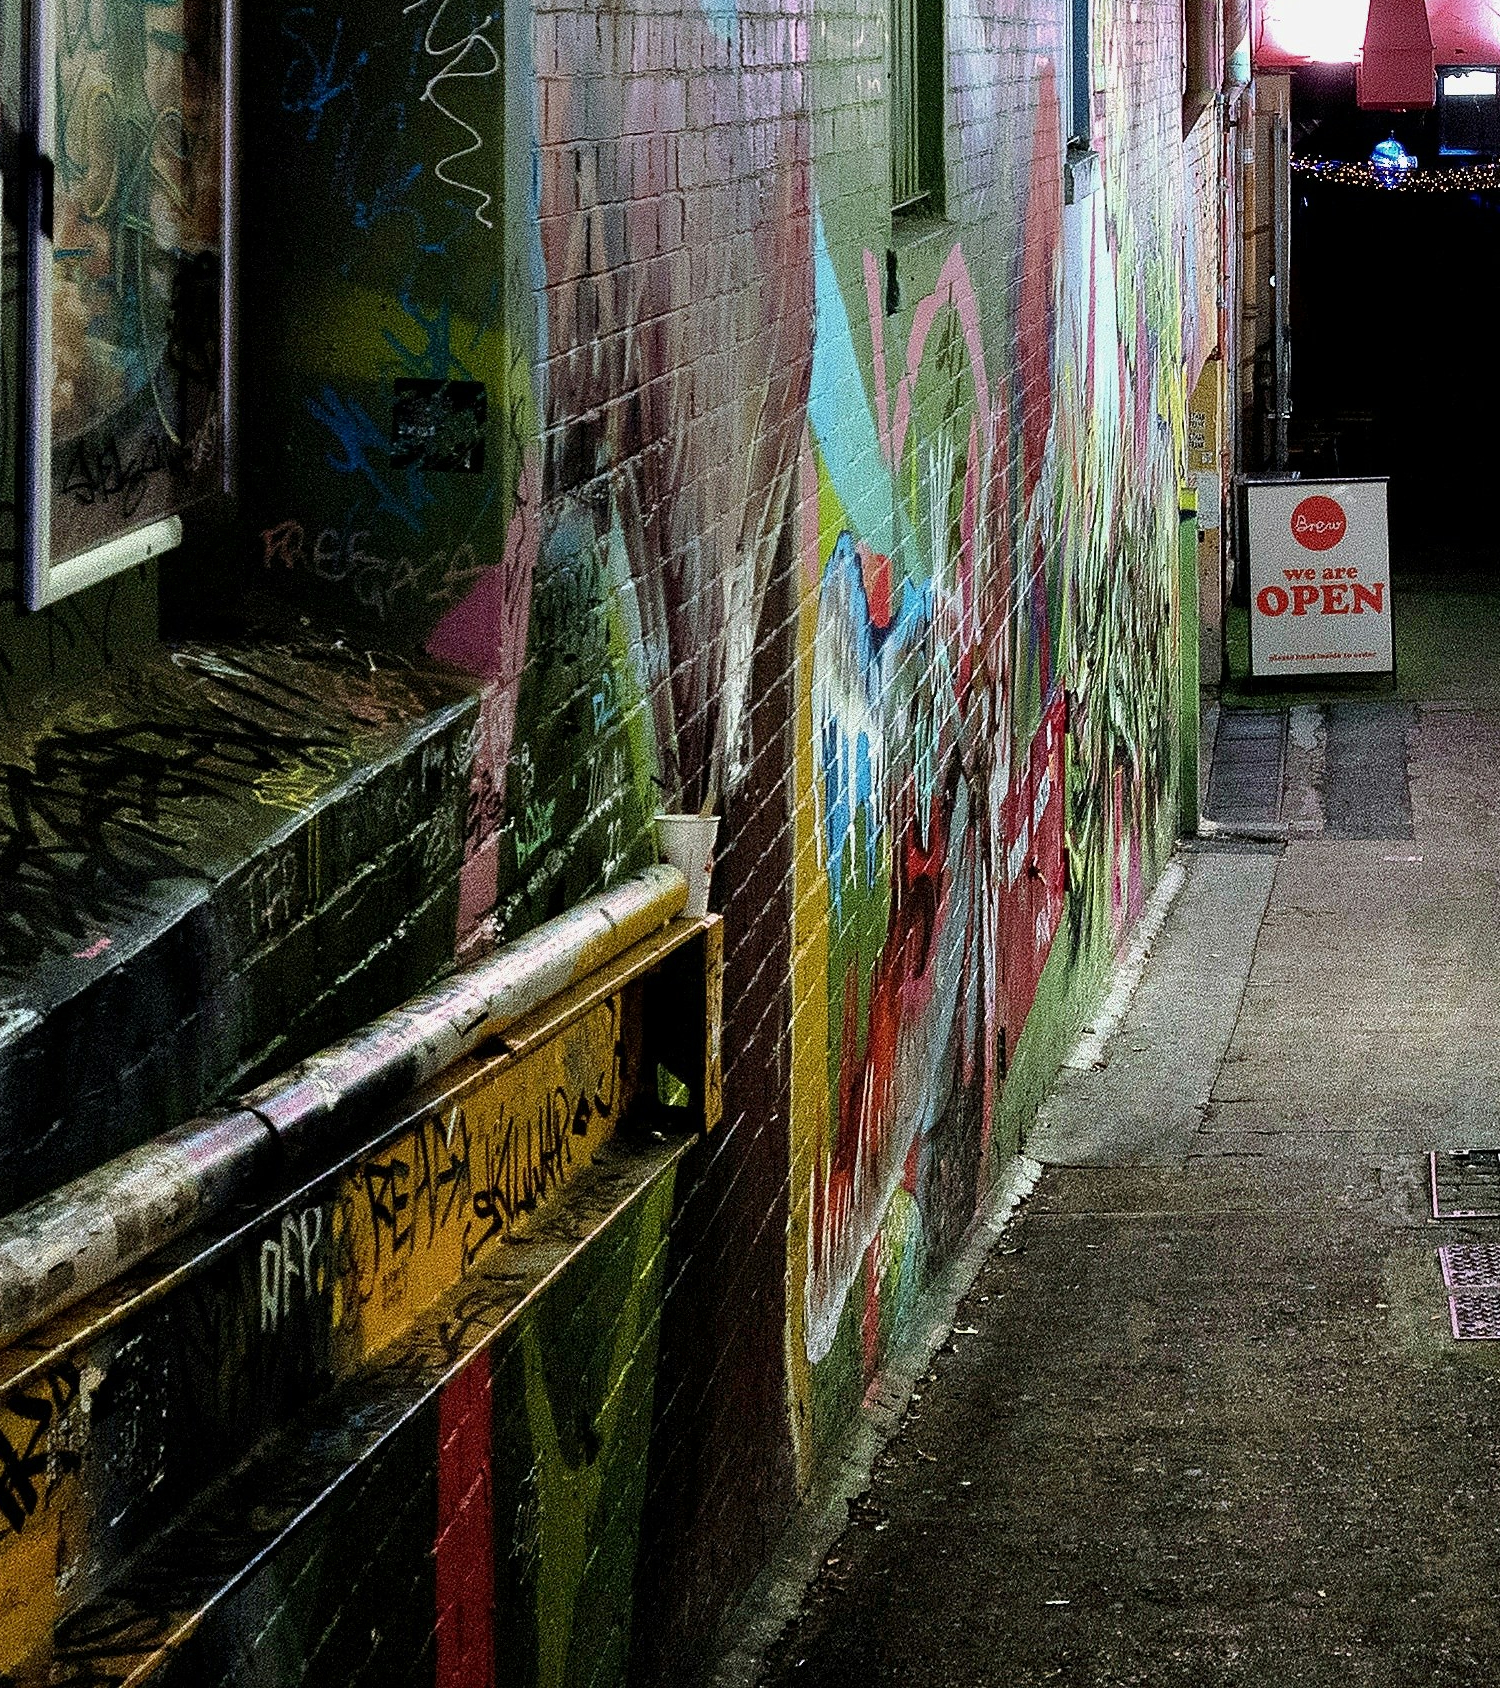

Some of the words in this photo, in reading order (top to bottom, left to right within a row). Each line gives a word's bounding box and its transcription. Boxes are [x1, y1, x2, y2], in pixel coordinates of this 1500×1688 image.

[1295, 514, 1343, 533] Brew
[1283, 567, 1316, 582] we
[1322, 566, 1359, 581] are
[1256, 582, 1385, 617] OPEN
